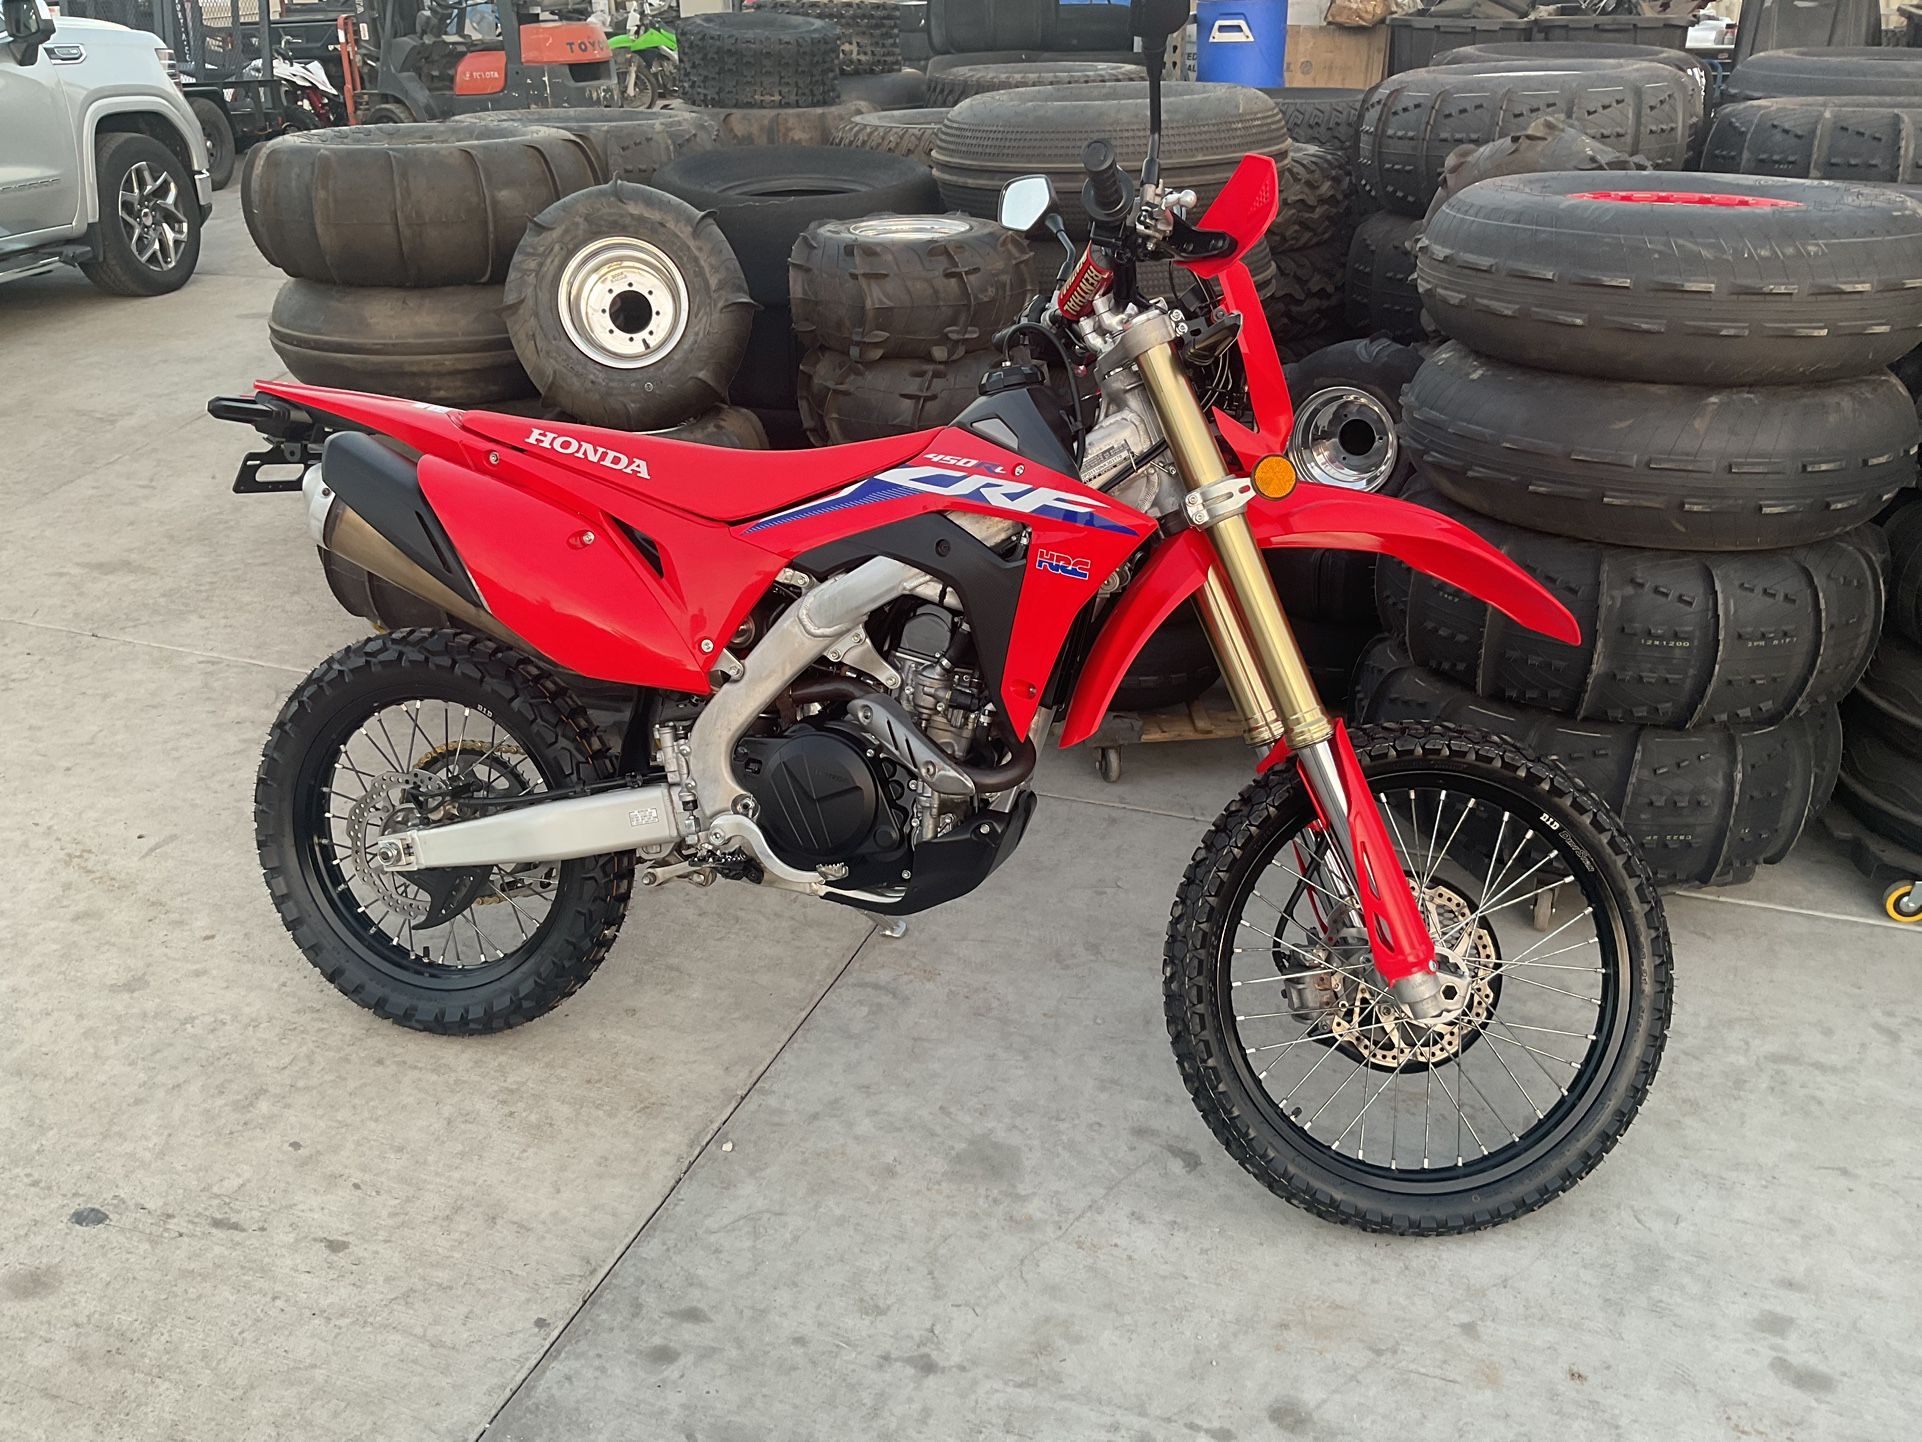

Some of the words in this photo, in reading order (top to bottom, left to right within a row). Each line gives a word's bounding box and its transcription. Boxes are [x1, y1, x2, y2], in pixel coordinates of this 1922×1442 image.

[1063, 265, 1103, 316] RENTHAL
[524, 427, 651, 480] HONDA
[874, 466, 1111, 513] CRF
[1036, 548, 1091, 580] HRC
